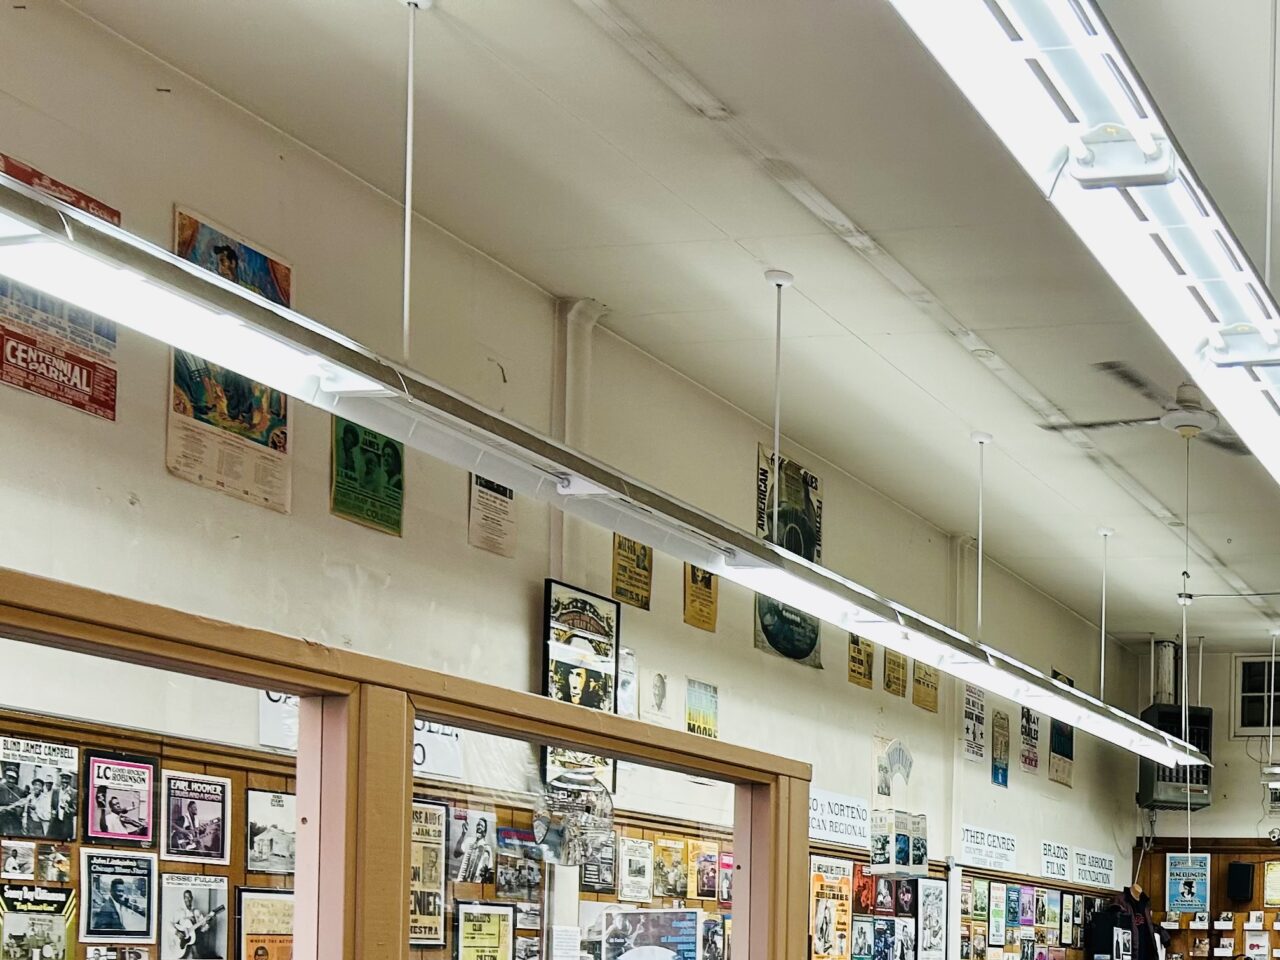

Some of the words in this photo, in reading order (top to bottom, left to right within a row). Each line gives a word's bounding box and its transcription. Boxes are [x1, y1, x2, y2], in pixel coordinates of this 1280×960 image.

[5, 340, 92, 393] CENTENNIAL
[28, 361, 69, 384] PARK
[757, 467, 769, 531] AMERICAN
[170, 779, 192, 792] EARL
[191, 781, 223, 796] HOOKER
[827, 801, 868, 822] NORTEÑO
[829, 820, 867, 838] REGIONAL
[986, 833, 1016, 852] GENRES
[1042, 842, 1069, 861] BRAZOS
[1046, 860, 1066, 877] FILMS
[1075, 852, 1087, 866] THE
[1078, 867, 1111, 885] FOUNDATION
